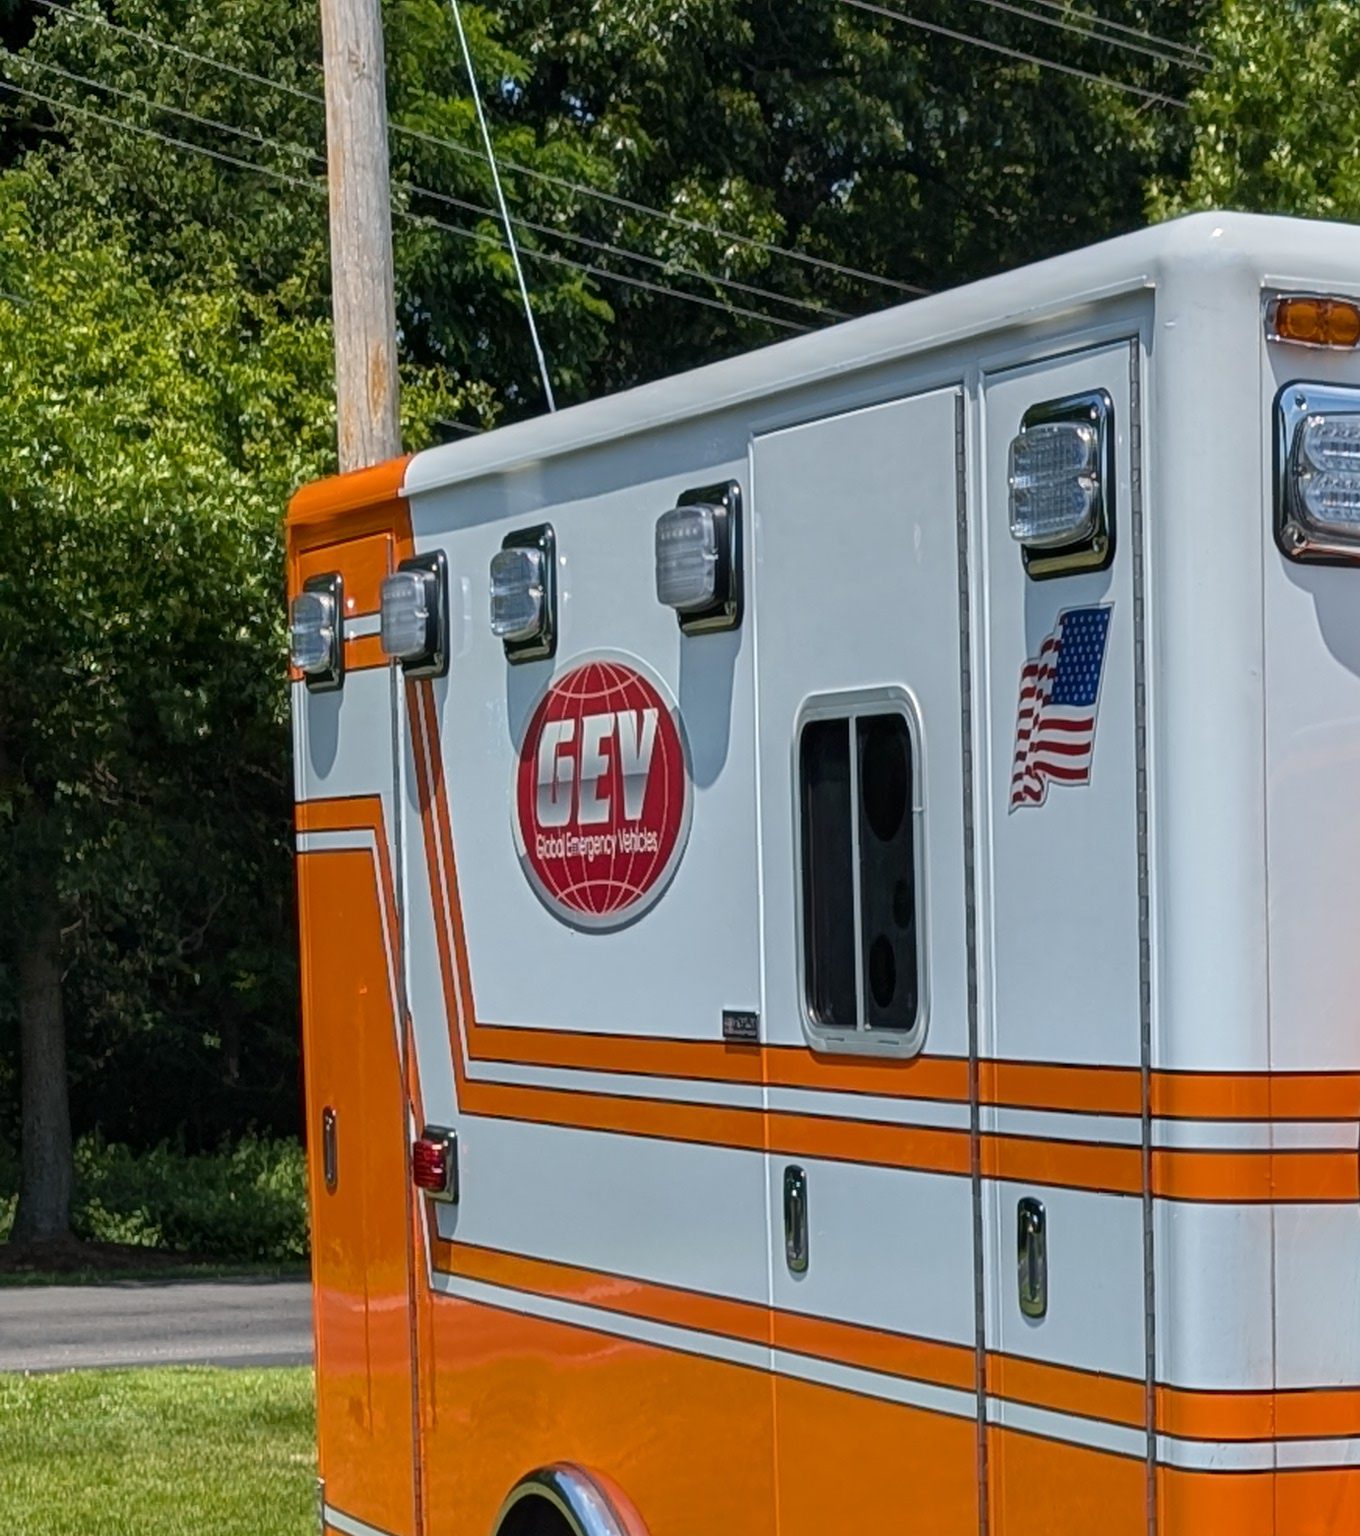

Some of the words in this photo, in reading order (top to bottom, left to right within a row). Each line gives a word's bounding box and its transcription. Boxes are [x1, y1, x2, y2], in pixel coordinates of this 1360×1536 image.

[536, 708, 658, 828] GEV
[536, 833, 565, 859] Global
[566, 832, 616, 862] Emergency
[617, 826, 658, 853] Vehicles
